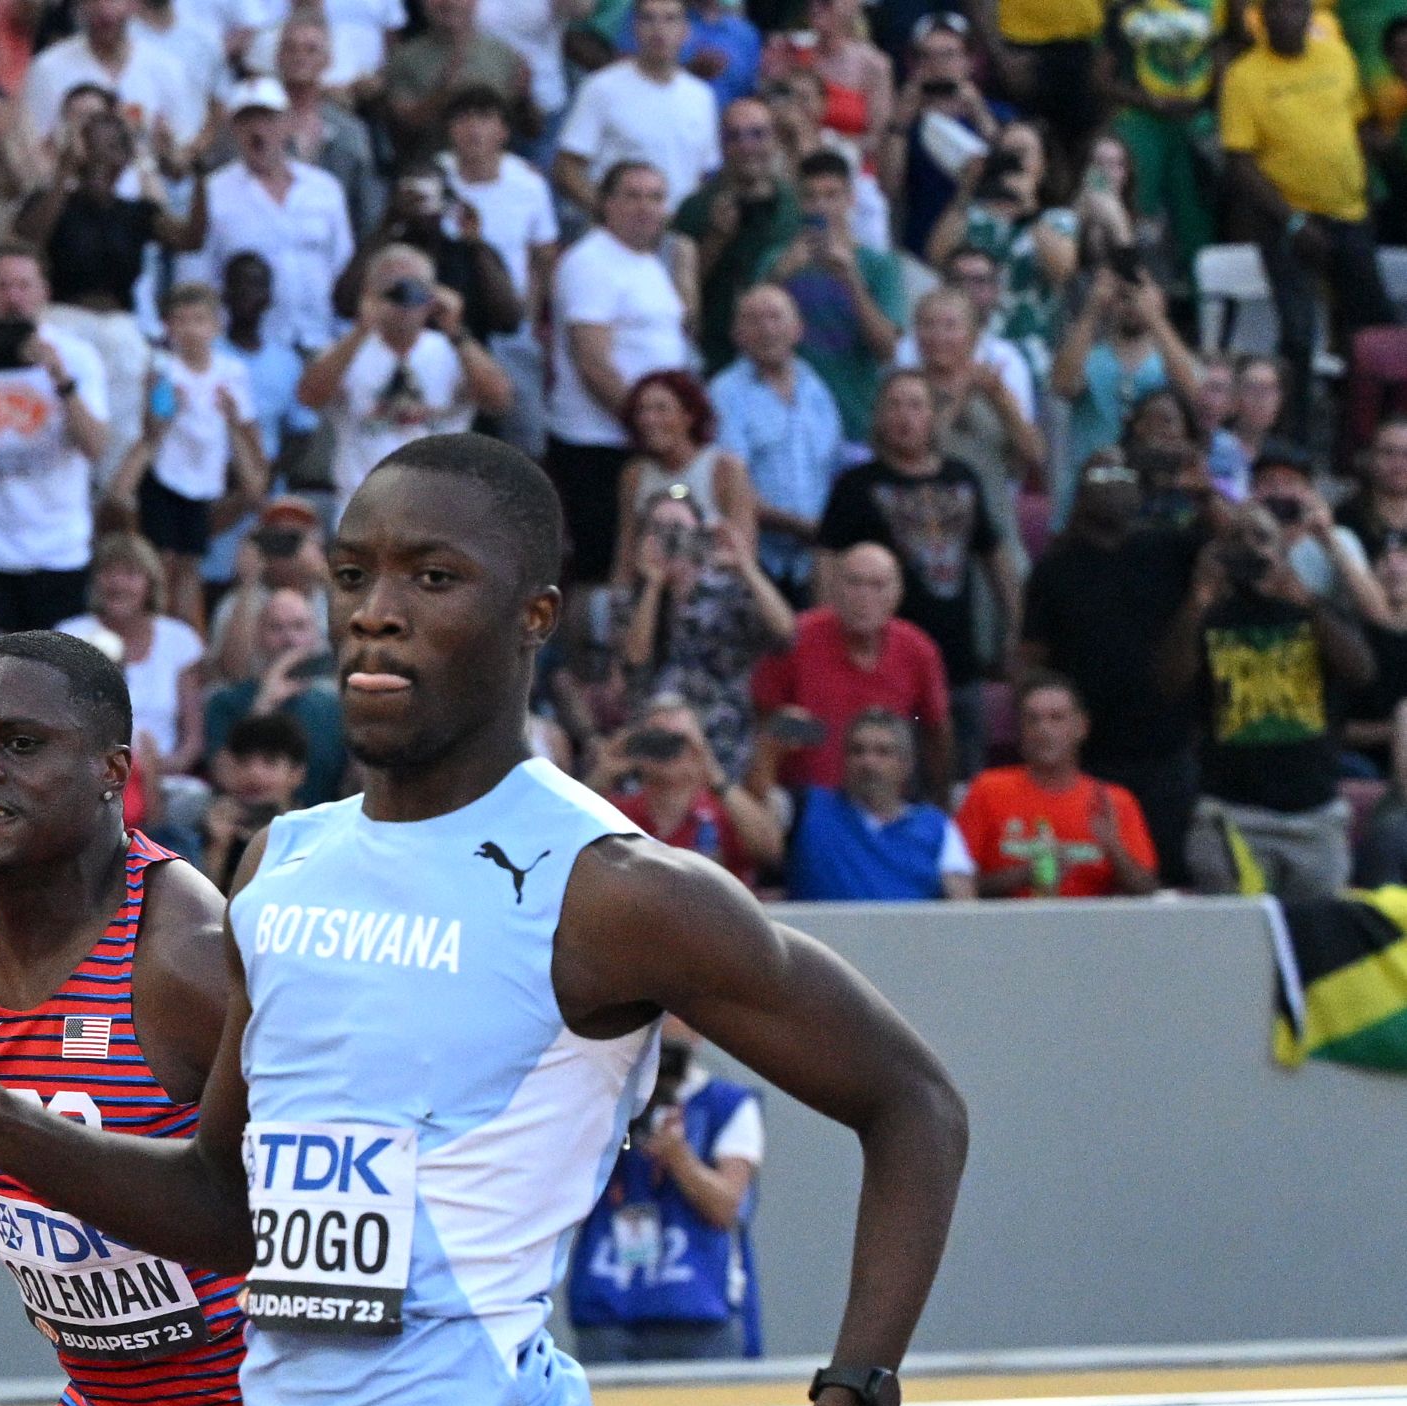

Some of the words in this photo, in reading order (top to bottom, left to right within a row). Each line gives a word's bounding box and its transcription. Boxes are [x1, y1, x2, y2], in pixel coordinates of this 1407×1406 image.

[254, 903, 462, 975] BOTSWANA
[259, 1133, 395, 1196] TDK
[251, 1208, 390, 1275] BOGO
[5, 1258, 181, 1320] COLEMAN
[352, 1300, 385, 1323] 23
[61, 1328, 161, 1351] BUDAPEST
[162, 1321, 194, 1343] 23
